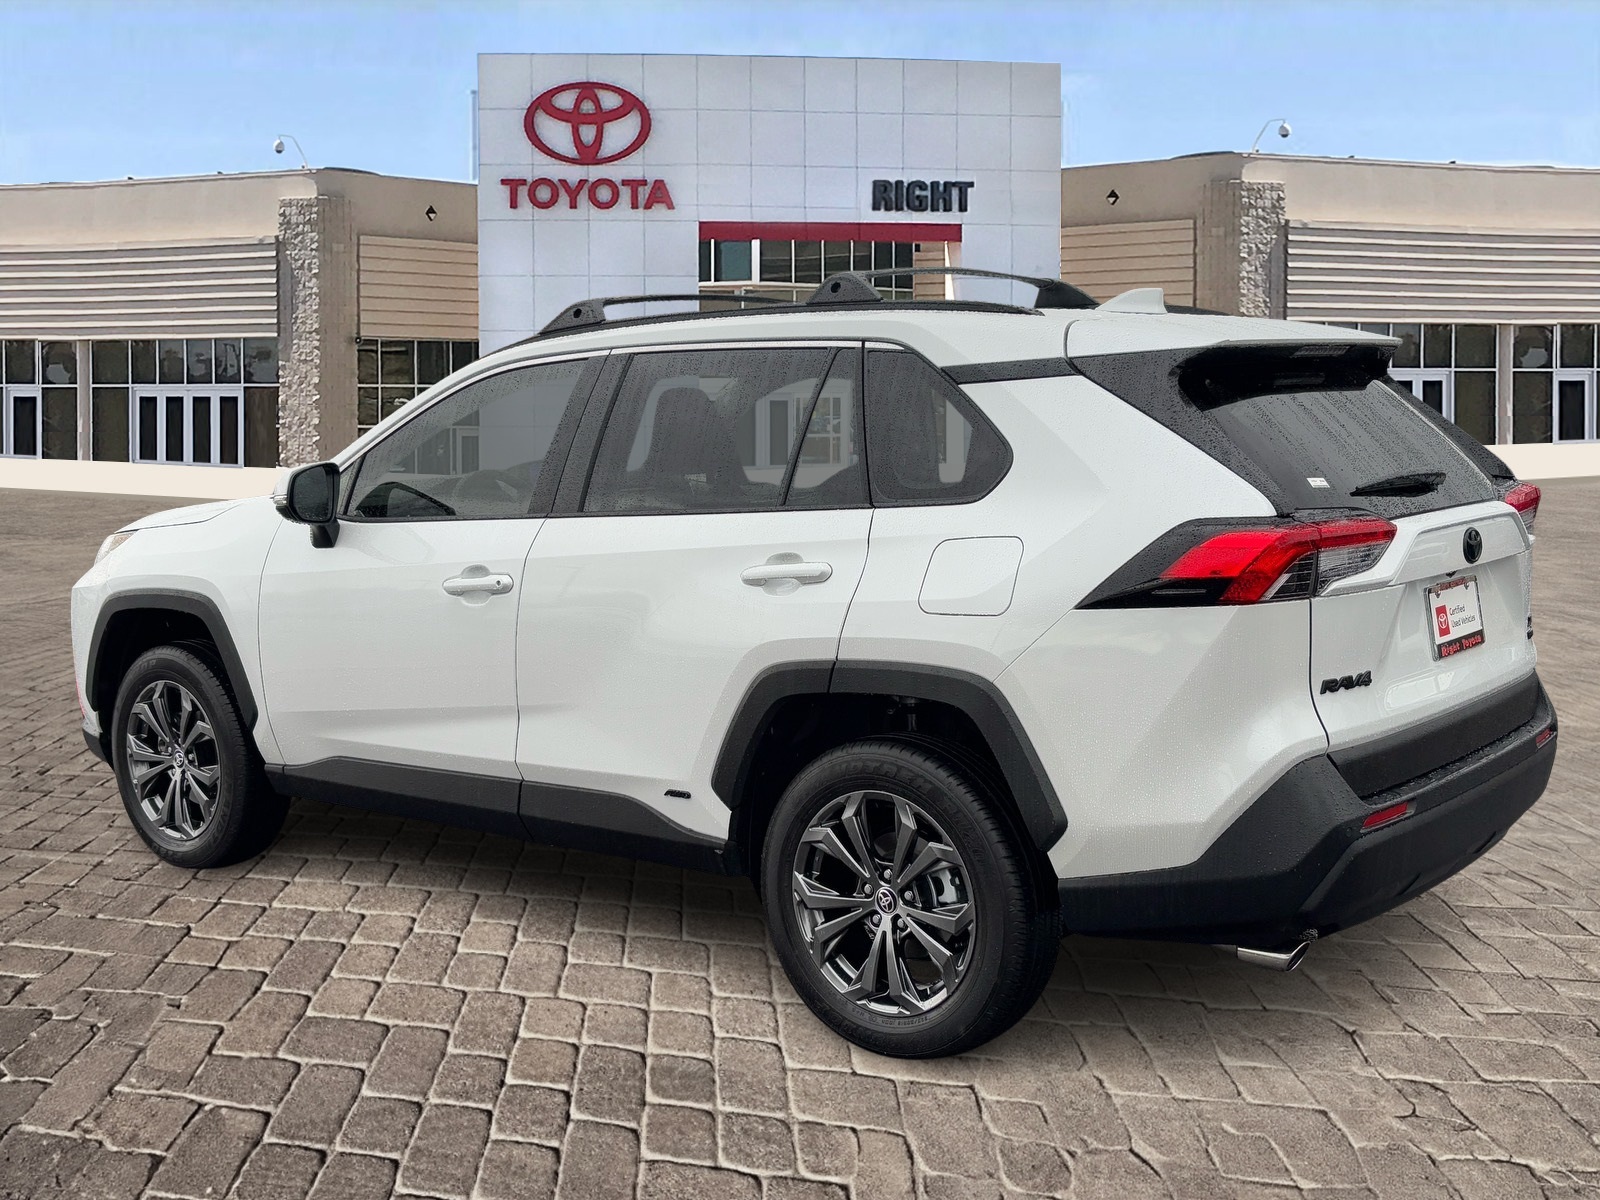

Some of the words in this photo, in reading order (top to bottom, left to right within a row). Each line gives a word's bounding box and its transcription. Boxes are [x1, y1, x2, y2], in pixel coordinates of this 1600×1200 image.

[500, 178, 675, 211] TOYOTA
[871, 179, 975, 213] RIGHT
[1449, 604, 1465, 616] Certified
[1451, 617, 1461, 628] Used
[1461, 614, 1476, 625] Vehicles
[1441, 642, 1460, 657] Right
[1461, 634, 1482, 650] Toyota
[1319, 669, 1373, 695] RAV4
